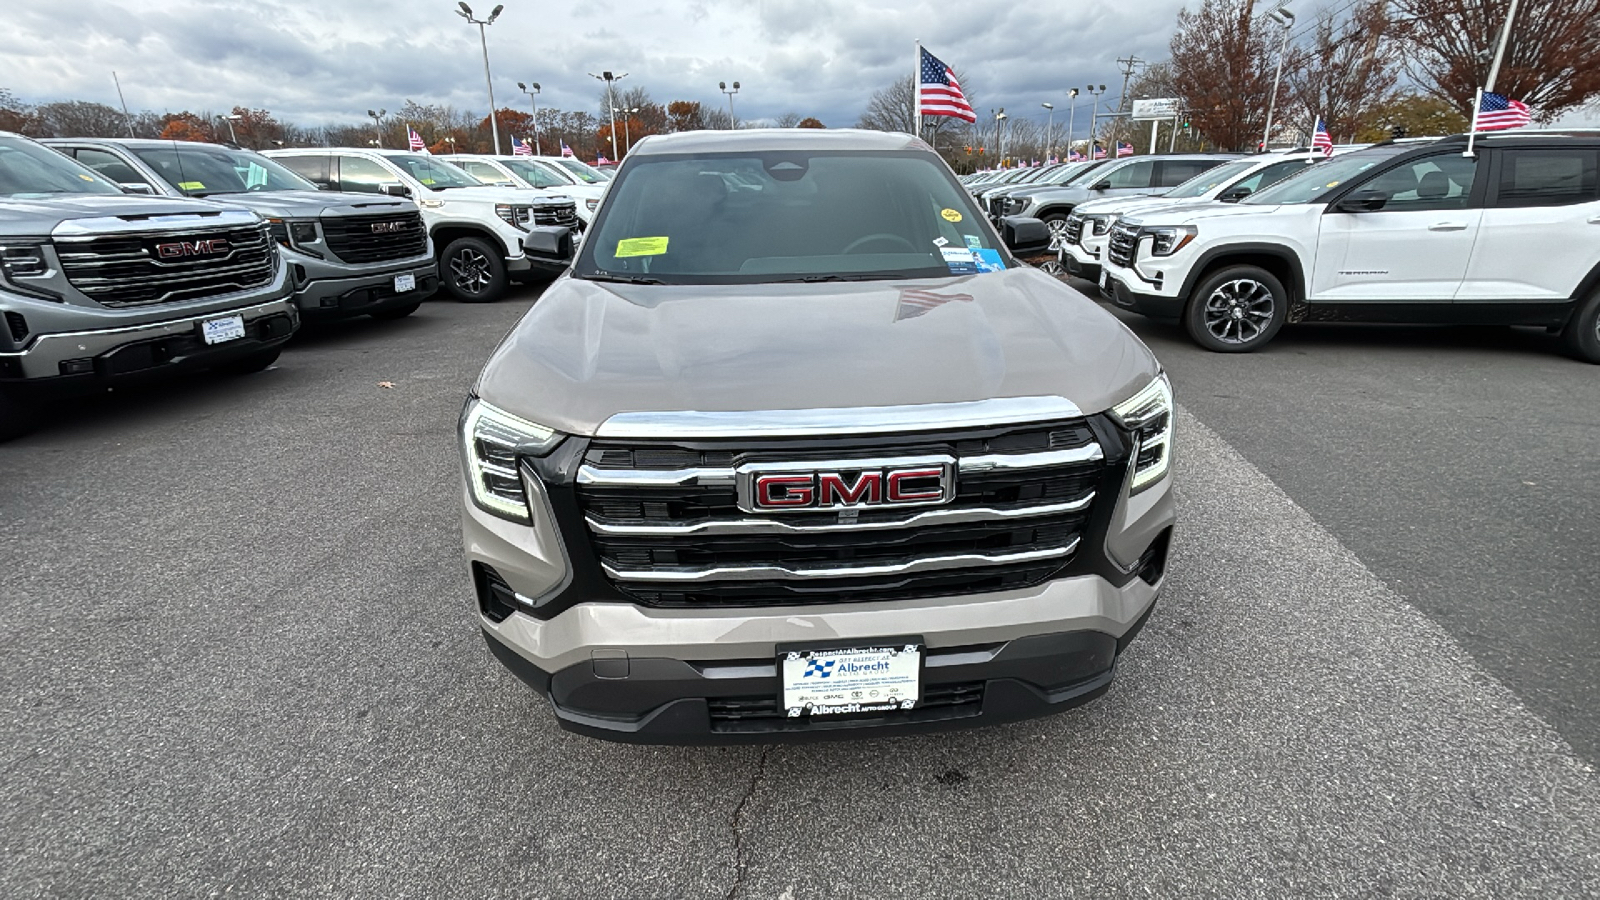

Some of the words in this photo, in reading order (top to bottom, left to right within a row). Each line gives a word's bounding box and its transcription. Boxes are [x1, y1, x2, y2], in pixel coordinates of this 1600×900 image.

[371, 221, 407, 233] GMC
[156, 239, 229, 258] GMC
[756, 467, 945, 508] GMC
[810, 647, 895, 658] RespectAtAlbrecht.com
[838, 661, 890, 673] Albrecht
[810, 702, 861, 715] Albrecht
